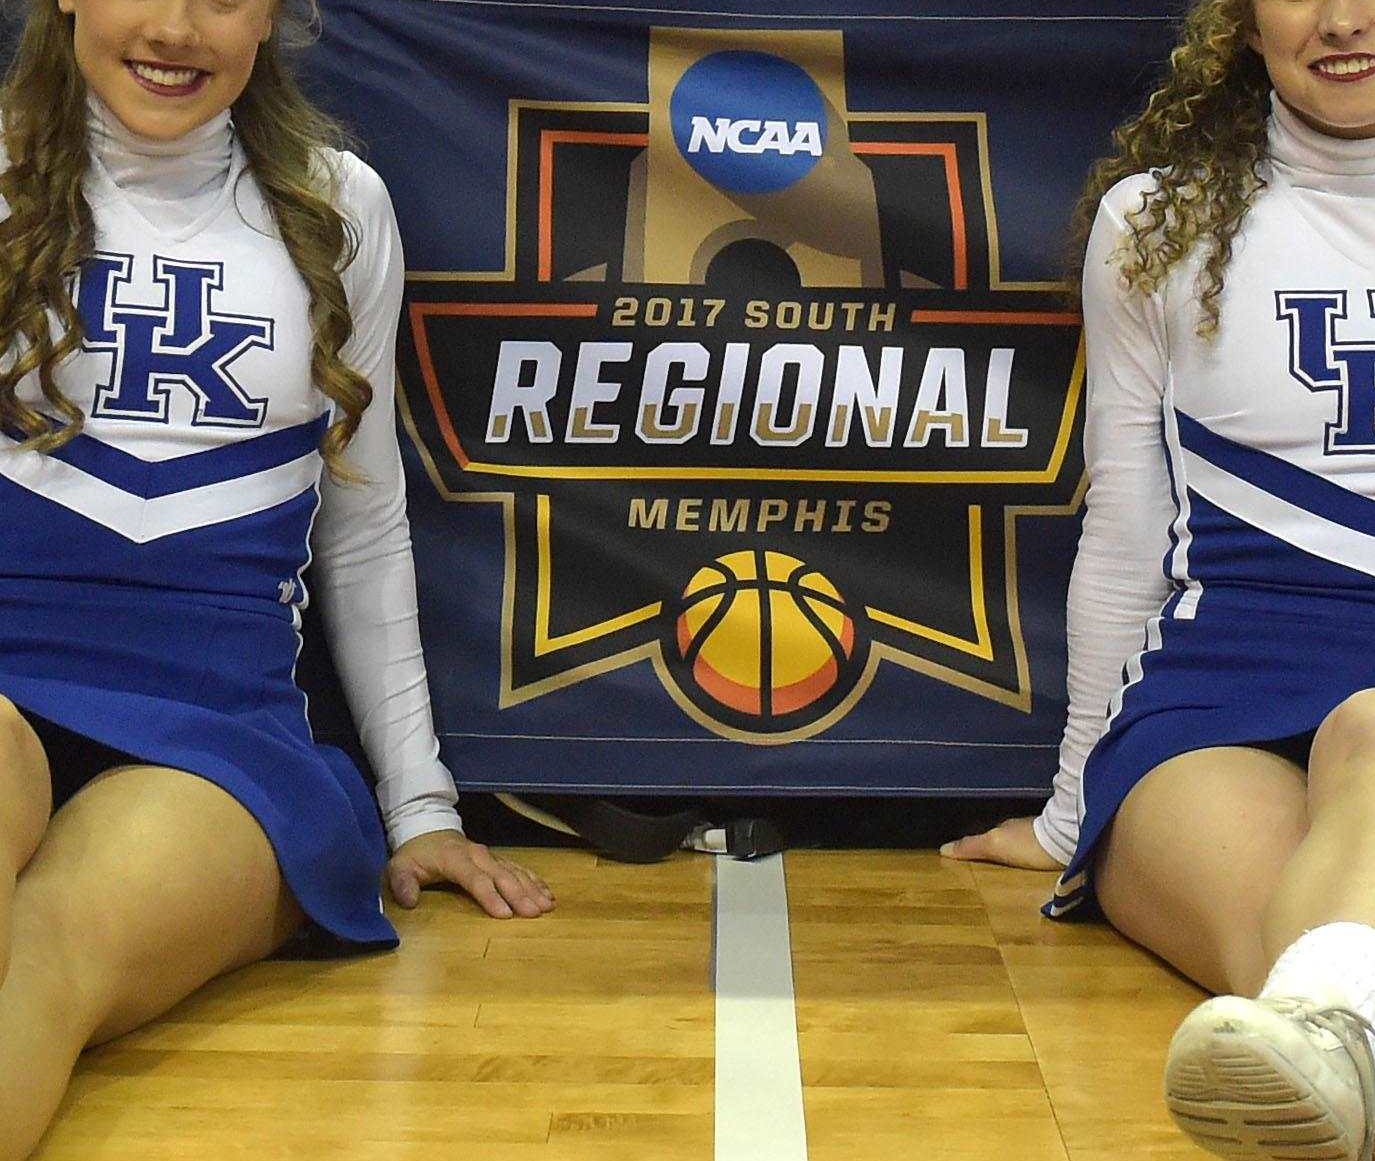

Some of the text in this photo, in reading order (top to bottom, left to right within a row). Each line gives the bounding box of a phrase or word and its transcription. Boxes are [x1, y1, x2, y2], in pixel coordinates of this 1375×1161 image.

[687, 115, 823, 157] NCAA
[611, 296, 898, 332] 2017 SOUTH
[69, 251, 274, 427] UK
[484, 339, 1030, 449] REGIONAL
[627, 496, 893, 533] MEMPHIS
